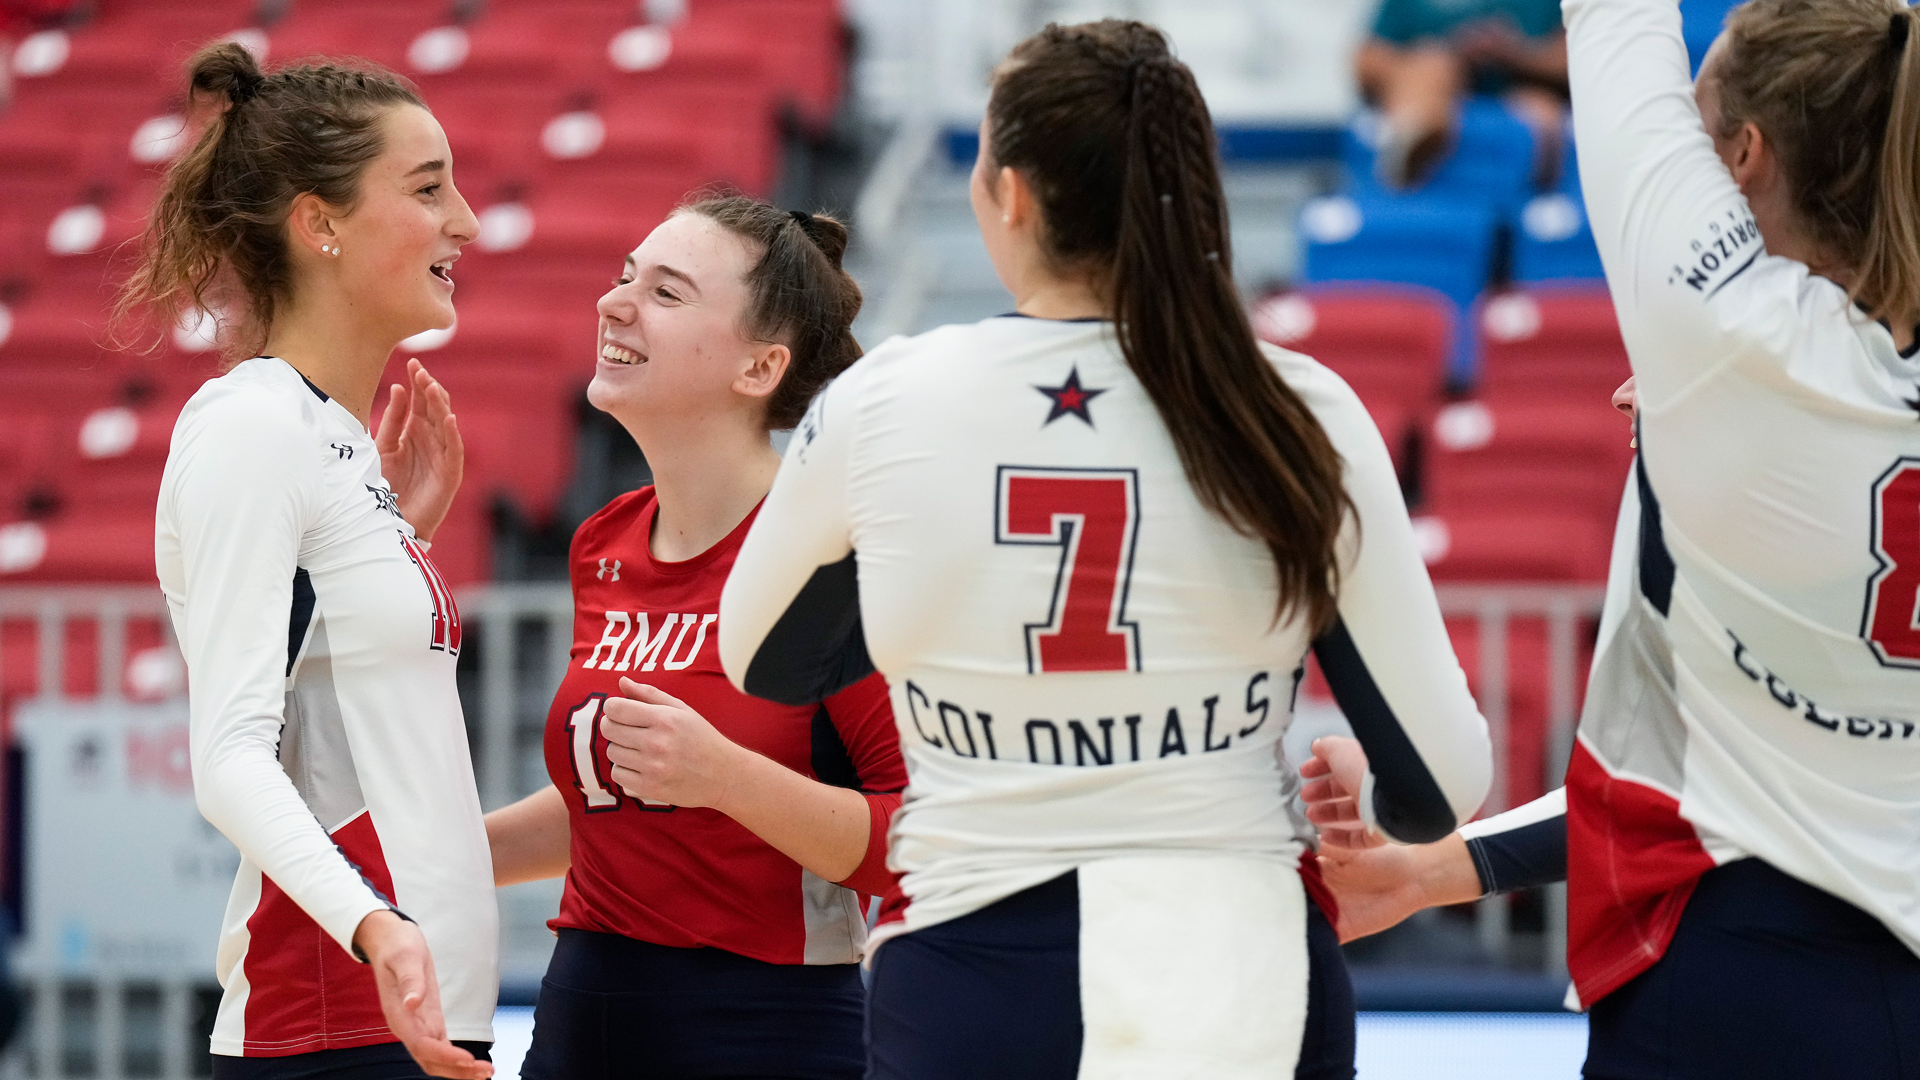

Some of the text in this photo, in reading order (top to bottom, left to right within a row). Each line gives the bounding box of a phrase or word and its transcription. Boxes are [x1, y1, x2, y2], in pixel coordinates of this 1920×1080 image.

[1686, 218, 1759, 292] ORIZON
[994, 464, 1142, 675] 7
[582, 610, 719, 672] RMU
[906, 671, 1269, 767] COLONIALS
